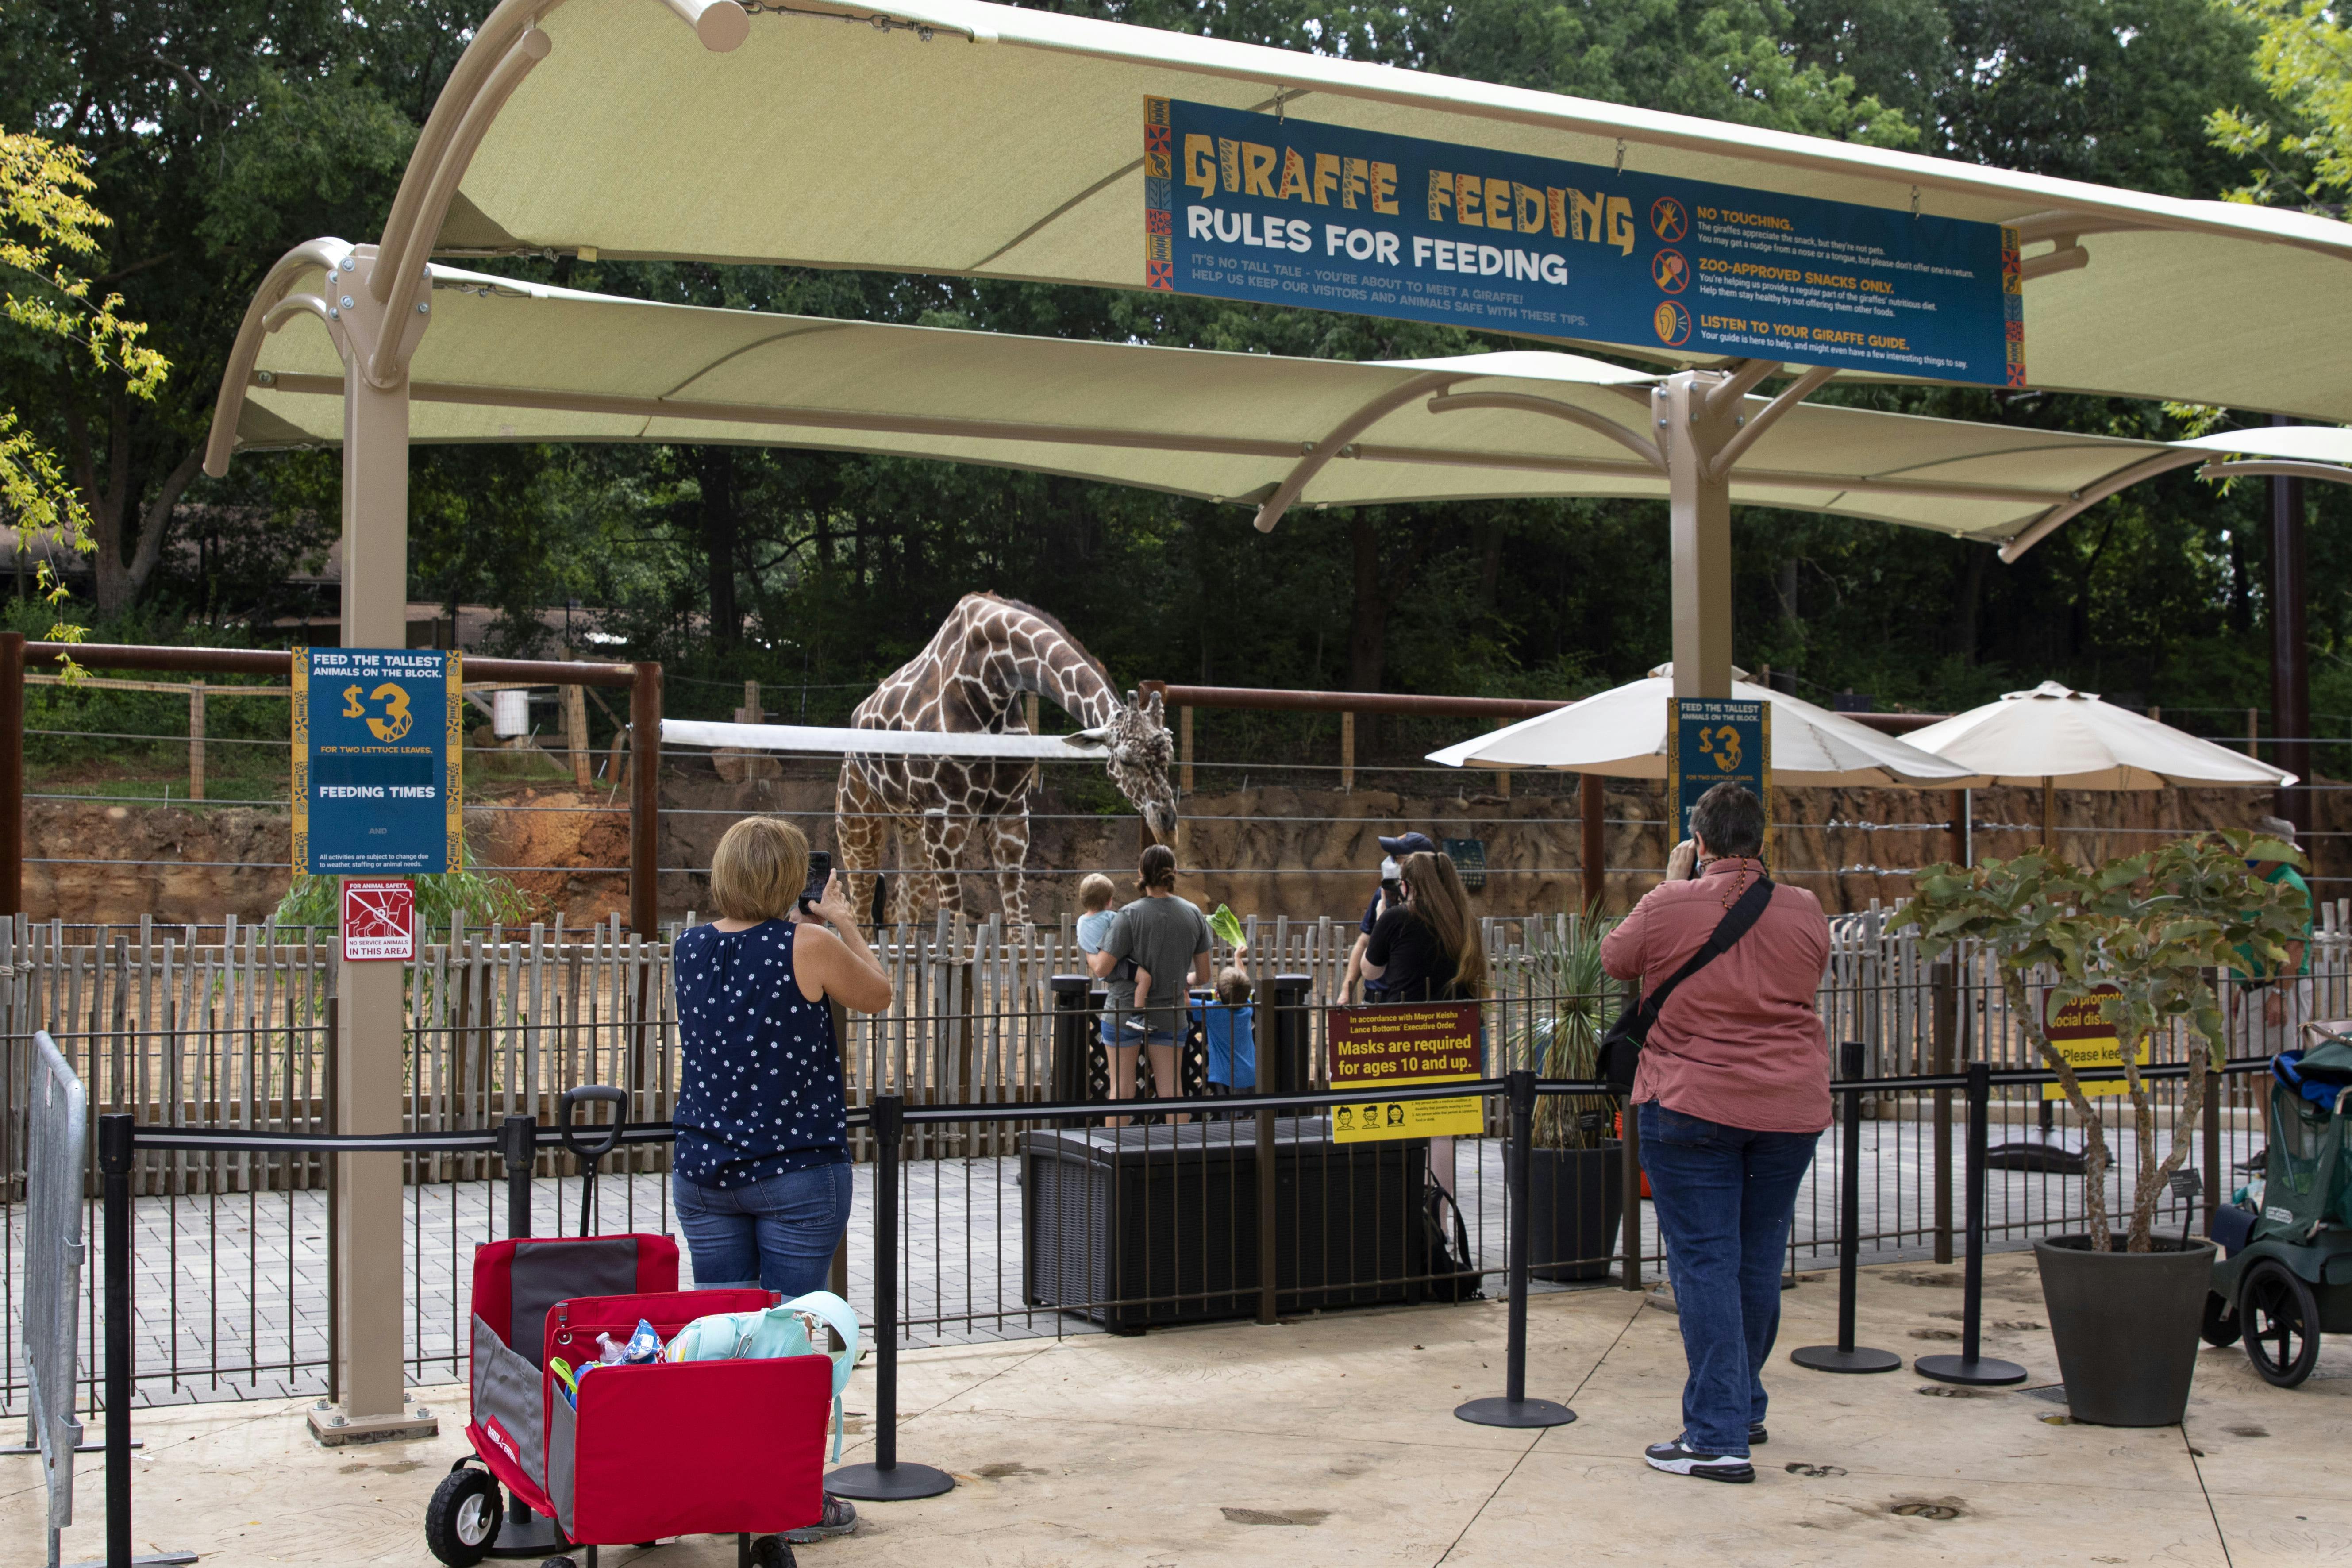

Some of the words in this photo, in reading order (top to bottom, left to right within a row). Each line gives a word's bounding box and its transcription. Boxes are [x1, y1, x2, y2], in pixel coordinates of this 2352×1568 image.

[1184, 133, 1399, 215] GIRAFFE
[1428, 170, 1635, 256] FEEDING
[1697, 206, 1717, 220] NO
[1721, 209, 1794, 231] TOUCHING.
[1187, 205, 1312, 253] RULES
[1325, 224, 1400, 266] FOR
[1413, 236, 1567, 285] FEEDING
[1192, 254, 1214, 266] IT'S
[1218, 257, 1237, 269] NO
[1241, 260, 1269, 273] TALL
[1273, 264, 1301, 277] TALE
[1314, 269, 1357, 284] YOU'RE
[1361, 276, 1402, 290] ABOUT
[1406, 281, 1423, 292] TO
[1426, 283, 1457, 296] MEET
[1461, 288, 1469, 298] A
[1472, 289, 1523, 304] GIRAFFE!
[1699, 258, 1801, 281] ZOO-APPROVED
[1805, 271, 1857, 289] SNACKS
[1860, 279, 1894, 294] ONLY.
[1192, 268, 1223, 282] HELP
[1227, 273, 1244, 285] US
[1248, 275, 1278, 289] KEEP
[1282, 280, 1308, 293] OUR
[1312, 284, 1367, 300] VISITORS
[1370, 291, 1396, 303] AND
[1399, 295, 1451, 310] ANIMALS
[1455, 301, 1483, 314] SAFE
[1486, 304, 1517, 317] WITH
[1520, 309, 1556, 322] THESE
[1560, 314, 1588, 326] TIPS.
[1700, 285, 1717, 296] Help
[1718, 287, 1737, 297] them
[1738, 291, 1754, 301] stay
[1755, 291, 1781, 304] healthy
[1782, 295, 1791, 306] by
[1805, 298, 1834, 311] offering
[1834, 302, 1853, 311] them
[1854, 305, 1872, 314] other
[1723, 276, 1751, 289] helping
[1762, 282, 1789, 292] provide
[1795, 287, 1821, 297] regular
[1837, 291, 1845, 299] of
[1846, 292, 1858, 301] the
[1888, 299, 1921, 308] nutritious
[1701, 315, 1746, 331] LISTEN
[1750, 320, 1769, 334] TO
[1773, 323, 1809, 339] YOUR
[1812, 328, 1864, 345] GIRAFFE
[1868, 335, 1909, 350] GUIDE.
[1701, 330, 1718, 339] Your
[1719, 333, 1740, 343] guide
[1741, 335, 1748, 343] is
[1749, 335, 1766, 345] here
[1766, 338, 1775, 347] to
[1794, 342, 1808, 350] and
[1809, 343, 1829, 354] might
[1848, 347, 1865, 357] have
[1872, 349, 1885, 358] few
[1886, 351, 1923, 365] interesting
[1923, 355, 1945, 367] things
[313, 654, 348, 665] FEED
[352, 655, 379, 666] THE
[384, 655, 442, 667] TALLEST
[313, 667, 359, 676] ANIMALS
[405, 669, 442, 678] BLOCK.
[1681, 703, 1702, 711] FEED
[1705, 703, 1721, 712] THE
[1724, 704, 1759, 713] TALLEST
[320, 786, 384, 797] FEEDING
[389, 786, 435, 798] TIMES
[1358, 1014, 1397, 1023] accordance
[1403, 1022, 1435, 1031] Executive
[1338, 1039, 1384, 1055] Masks
[1388, 1041, 1411, 1052] are
[1414, 1034, 1471, 1052] required
[2063, 1048, 2099, 1062] Please
[2102, 1047, 2121, 1060] kee
[1338, 1060, 1359, 1075] for
[1363, 1061, 1397, 1076] ages
[1401, 1057, 1418, 1071] 10
[1421, 1055, 1447, 1070] and
[1451, 1057, 1471, 1071] up.
